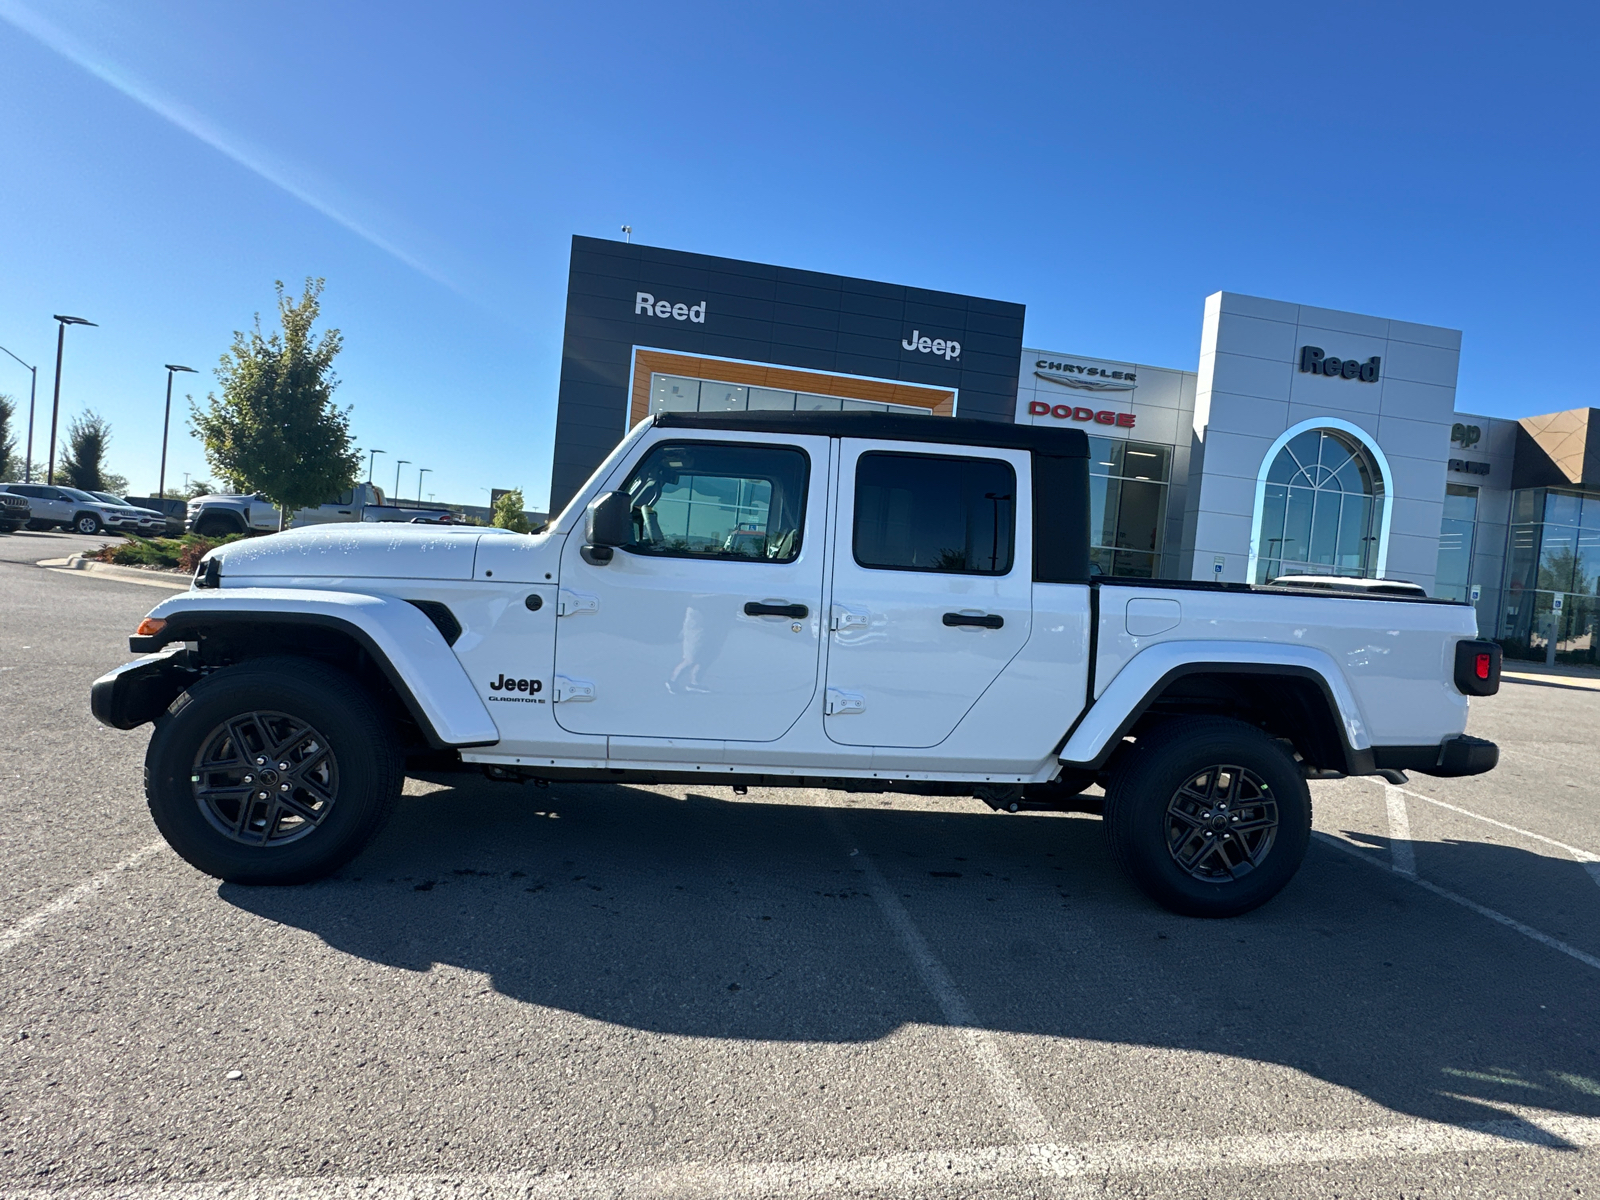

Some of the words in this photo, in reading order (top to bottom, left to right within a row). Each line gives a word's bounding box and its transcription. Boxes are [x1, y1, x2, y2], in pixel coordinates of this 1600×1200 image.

[635, 291, 706, 324] Reed
[902, 330, 961, 361] Jeep
[1036, 360, 1137, 381] CHRYSLER
[1300, 345, 1381, 383] Reed
[1029, 401, 1137, 428] DODGE
[1451, 423, 1481, 449] ep
[1448, 459, 1491, 476] AM
[490, 673, 543, 696] Jeep
[488, 696, 538, 704] GLADIATOR
